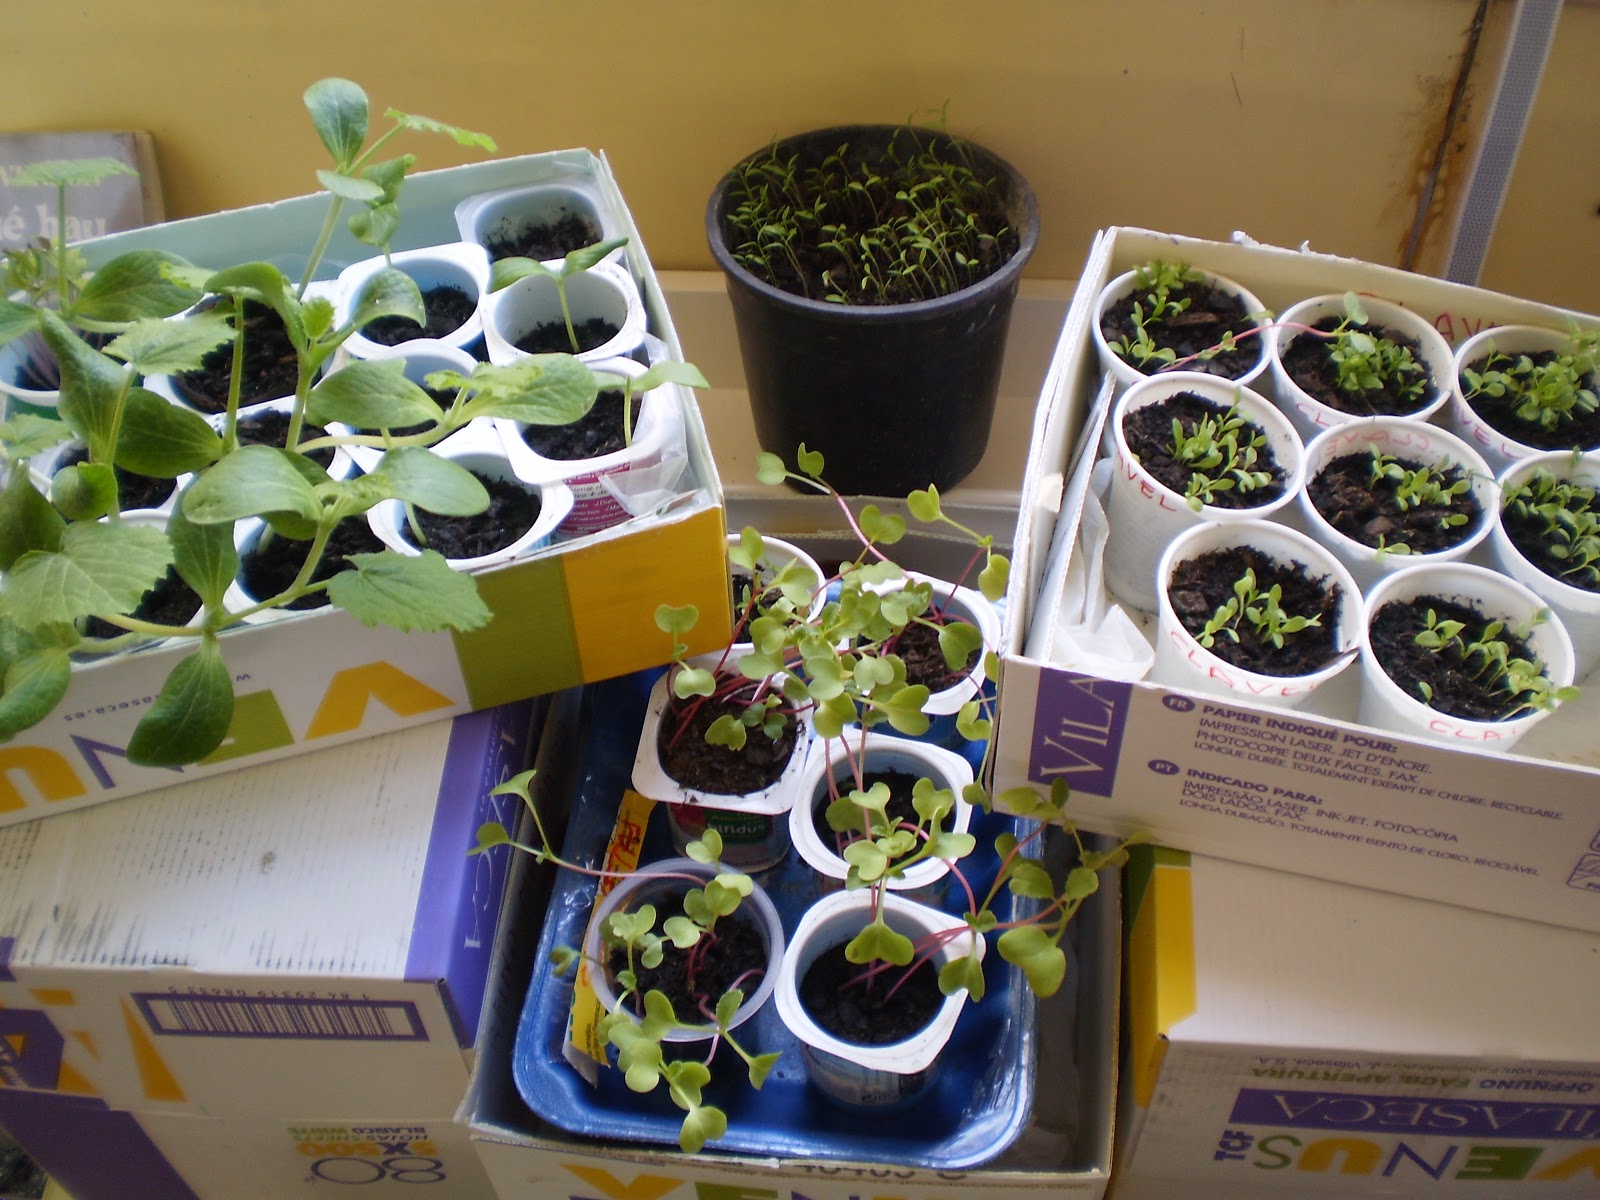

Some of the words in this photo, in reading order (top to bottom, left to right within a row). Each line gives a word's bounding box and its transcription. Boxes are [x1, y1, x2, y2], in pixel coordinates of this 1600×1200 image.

[1196, 730, 1290, 757] PHOTOCOPIE
[1293, 751, 1332, 766] DEUX
[1200, 718, 1287, 744] IMPRESSION
[1340, 749, 1361, 760] JET
[1203, 705, 1261, 725] PAPIER
[1266, 718, 1339, 741] INDIQUÉ
[1344, 734, 1398, 753] POUR:
[1187, 768, 1269, 793] INDICADO
[1273, 787, 1323, 806] PARA:
[1194, 741, 1243, 759] LONGUE
[1292, 762, 1368, 784] TOTALEMENT
[1372, 778, 1417, 793] EXEMPT
[1419, 787, 1435, 797] DE
[1182, 788, 1217, 802] DOIS
[1184, 780, 1263, 804] IMPRESSÃO
[1374, 820, 1458, 843] FOTOCÓPIA
[1180, 799, 1222, 815] LONGA
[1289, 822, 1364, 843] TOTALMENTE
[1366, 837, 1408, 851] ISENTO
[1410, 846, 1426, 854] DE
[1251, 1066, 1392, 1084] APERTURA
[1213, 1129, 1255, 1162] TCF
[310, 1155, 447, 1184] 80
